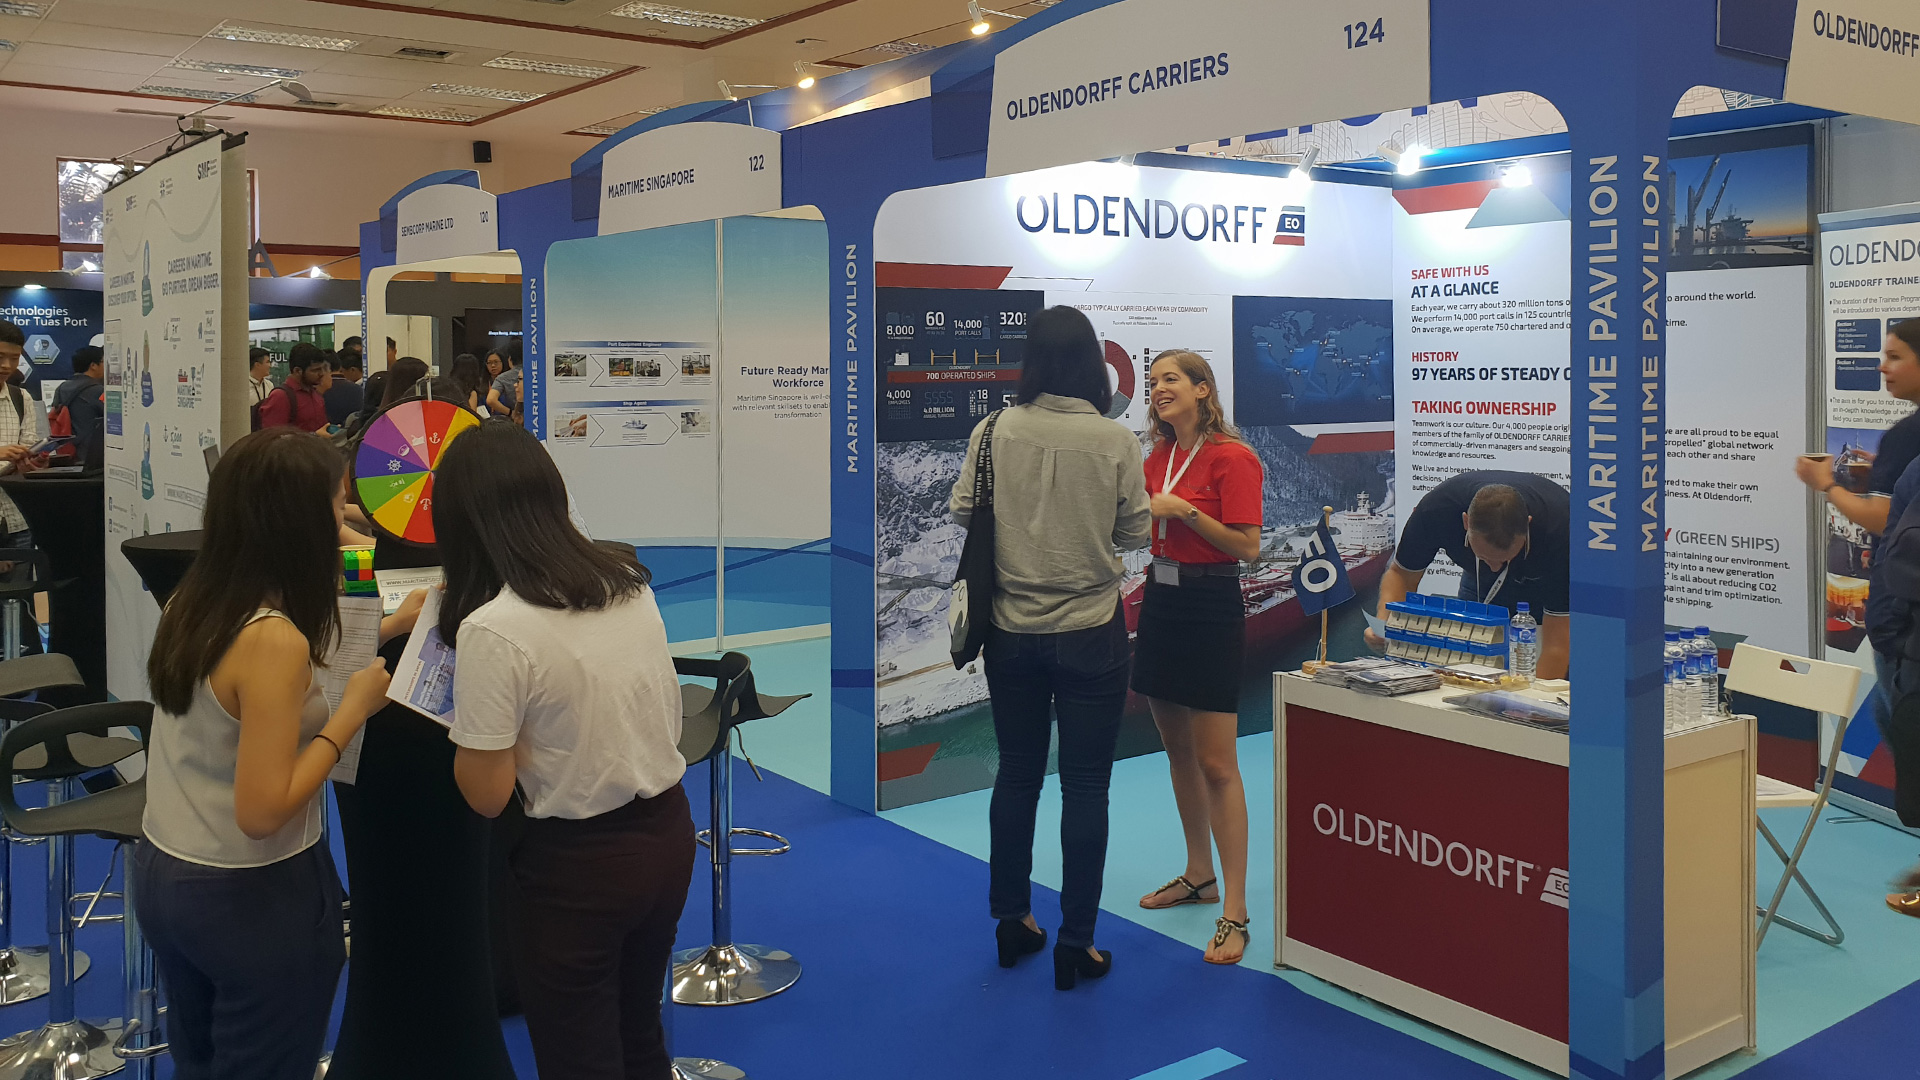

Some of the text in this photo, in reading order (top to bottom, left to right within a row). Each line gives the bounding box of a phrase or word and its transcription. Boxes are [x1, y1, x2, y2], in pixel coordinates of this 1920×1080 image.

[1344, 18, 1384, 50] 124
[1814, 10, 1920, 58] OLDENDORFF
[1006, 52, 1230, 121] OLDENDORFF CARRIERS
[748, 155, 764, 172] 122
[608, 168, 694, 199] MARITIME SINGAPORE
[444, 218, 454, 229] LTD
[480, 210, 488, 224] 120
[1016, 192, 1300, 243] OLDENDORFF EO
[1830, 239, 1920, 266] OLDEND
[1412, 264, 1489, 280] SAFE WITH US
[162, 281, 168, 296] GO
[188, 276, 204, 292] DREAM
[1830, 276, 1920, 288] OLDENDORFF TRAINE
[1411, 281, 1499, 298] AT A GLANCE
[1674, 293, 1706, 302] around
[1708, 292, 1724, 300] the
[1726, 291, 1756, 300] world.
[0, 306, 68, 318] echnologies
[1428, 304, 1446, 312] year,
[1459, 304, 1478, 312] carry
[1479, 302, 1500, 310] about
[1502, 300, 1516, 308] 320
[1518, 300, 1544, 308] million
[14, 316, 30, 326] for
[34, 317, 60, 326] Tuas
[64, 317, 88, 326] Port
[926, 312, 945, 326] 60
[1000, 312, 1023, 326] 320
[1424, 315, 1452, 324] perform
[1454, 313, 1478, 321] 14,000
[1480, 313, 1495, 322] port
[1524, 310, 1537, 318] 125
[1539, 310, 1571, 318] countrie
[886, 325, 914, 336] 8,000
[954, 320, 982, 330] 14,000
[1422, 326, 1452, 334] average,
[1466, 324, 1494, 333] operate
[1495, 323, 1508, 331] 750
[1510, 322, 1548, 330] chartered
[1550, 322, 1565, 330] and
[845, 244, 858, 474] MARITIME PAVILION
[1412, 352, 1459, 362] HISTORY
[1588, 155, 1618, 550] MARITIME PAVILION
[1642, 155, 1660, 552] MARITIME PAVILION
[741, 366, 829, 376] Future Ready Mar
[940, 372, 976, 380] OPERATED
[977, 371, 996, 380] SHIPS
[1412, 368, 1428, 380] 97
[1430, 368, 1475, 380] YEARS
[1479, 368, 1498, 380] OF
[1501, 367, 1560, 380] STEADY
[773, 378, 824, 388] Workforce
[886, 390, 911, 400] 4,000
[977, 389, 988, 400] 18
[1412, 400, 1556, 416] TAKING OWNERSHIP
[1702, 428, 1728, 438] proud
[1741, 430, 1752, 438] be
[1754, 430, 1780, 439] equal
[1707, 440, 1774, 450] global network
[1412, 450, 1446, 458] knowledge
[1666, 450, 1686, 458] each
[1688, 450, 1711, 459] other
[1730, 453, 1756, 461] share
[1692, 480, 1716, 488] make
[1717, 482, 1738, 490] their
[1740, 483, 1758, 491] own
[1692, 492, 1752, 503] At Oldendorff,
[1676, 530, 1727, 546] (GREEN
[1732, 536, 1780, 554] SHIPS)
[1731, 557, 1790, 570] environment.
[1680, 562, 1697, 571] into
[1726, 569, 1774, 580] generation
[1680, 574, 1690, 582] all
[1692, 576, 1718, 586] about
[1719, 580, 1757, 592] reducing
[1759, 582, 1777, 592] CO2
[1686, 586, 1783, 604] and trim optimization.
[1676, 596, 1714, 609] shipping.
[1313, 802, 1534, 894] OLDENDORFF
